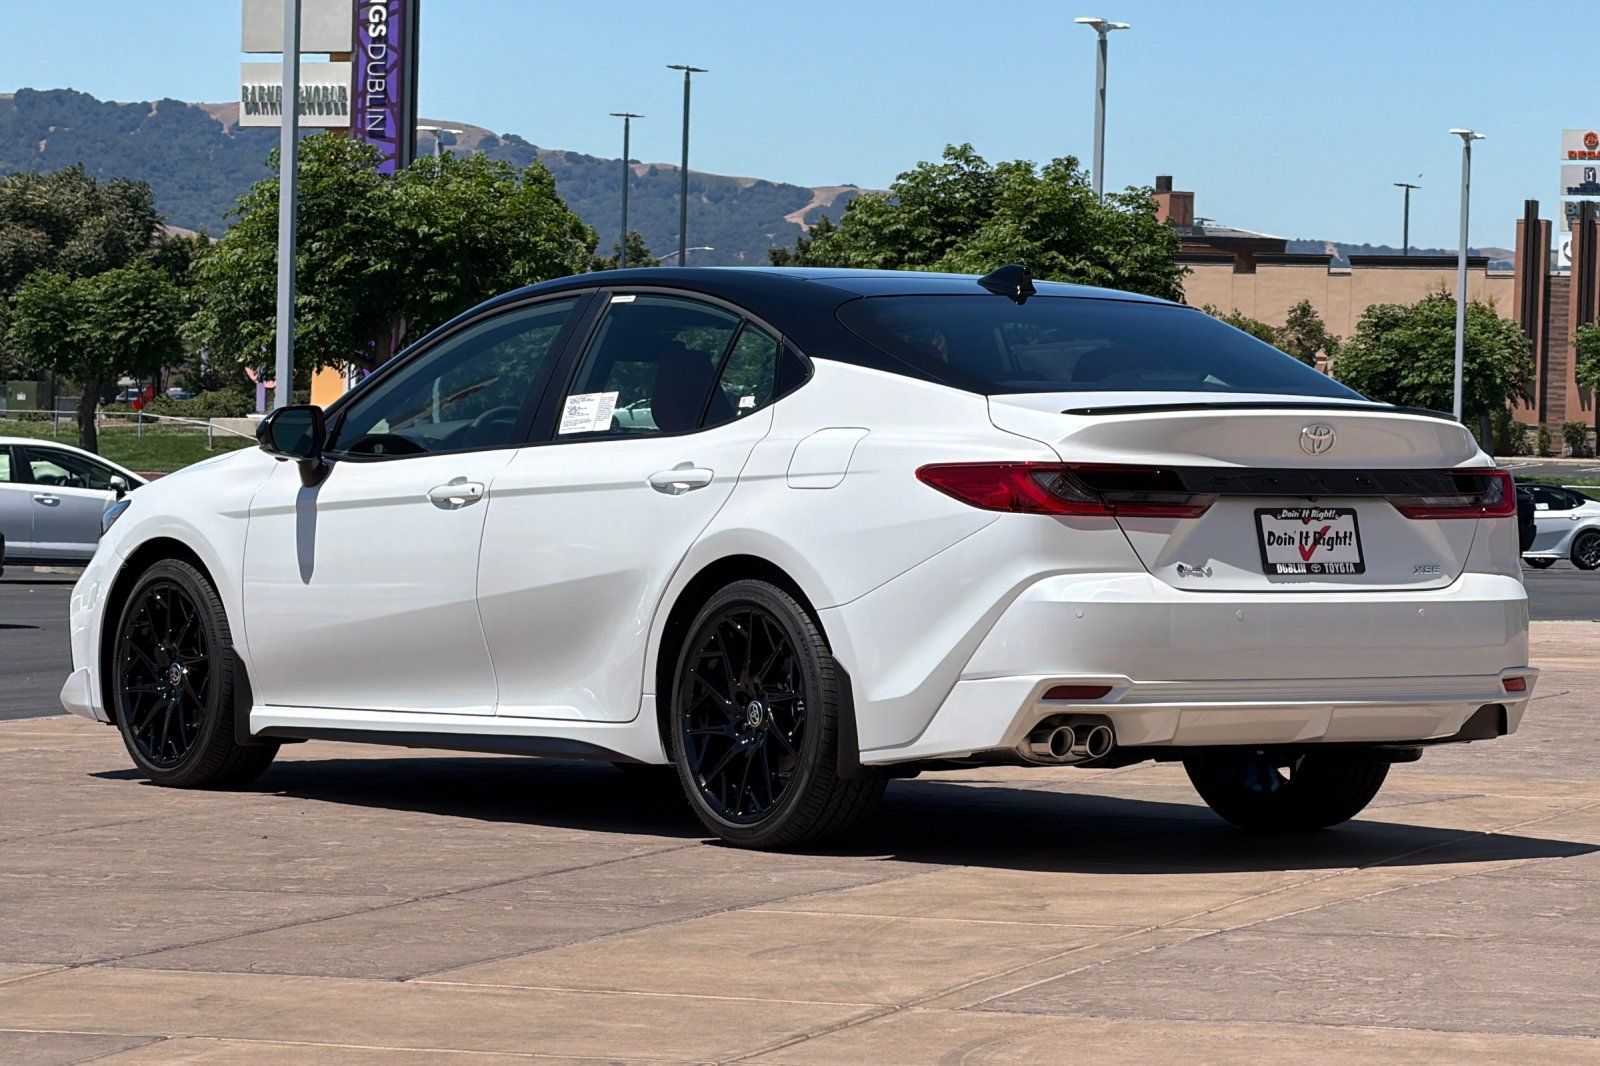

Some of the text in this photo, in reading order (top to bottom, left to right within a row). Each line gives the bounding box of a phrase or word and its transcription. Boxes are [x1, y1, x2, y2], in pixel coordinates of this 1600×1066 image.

[241, 84, 283, 103] BARNE
[305, 84, 348, 103] NOBLE
[366, 44, 387, 131] DUBLIN
[1301, 510, 1311, 518] It
[1310, 509, 1337, 521] Right!
[1266, 530, 1353, 551] Doin' It Right!
[1276, 563, 1356, 574] DUBLIN TOYOTA
[1412, 565, 1441, 575] XSE
